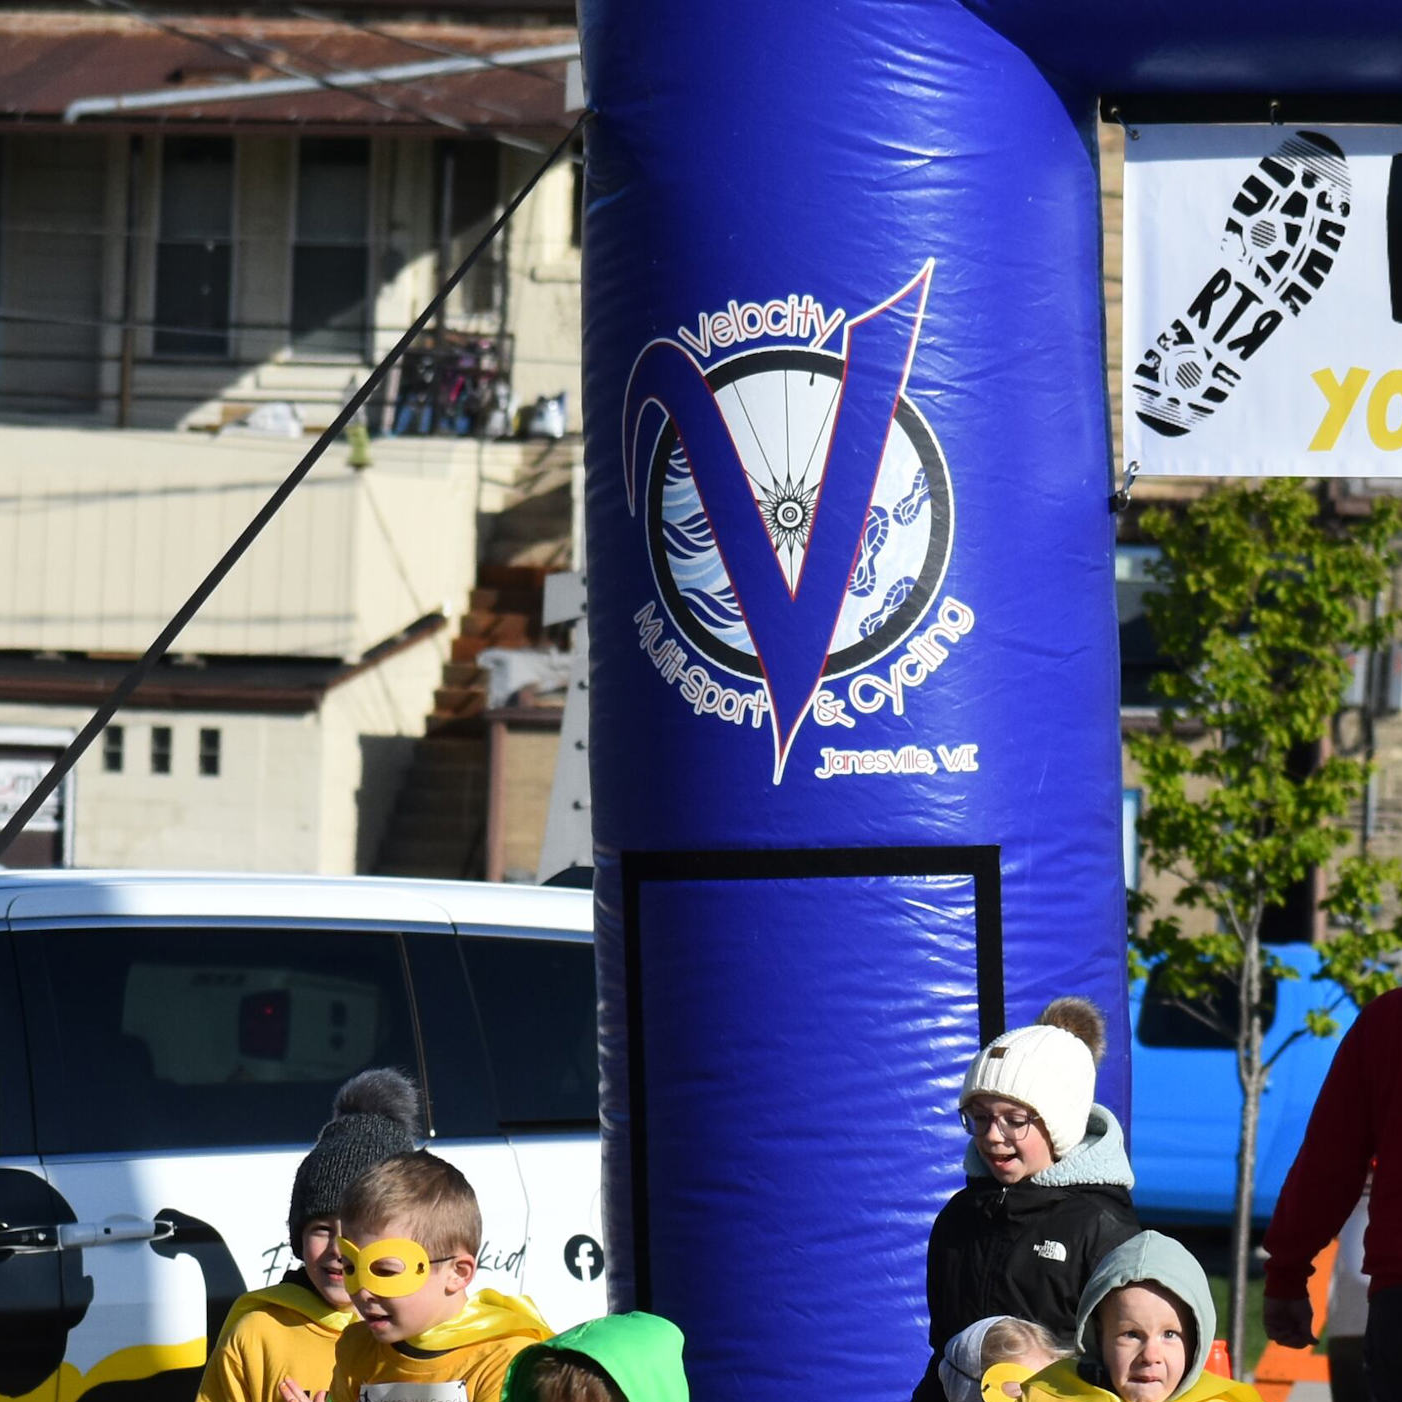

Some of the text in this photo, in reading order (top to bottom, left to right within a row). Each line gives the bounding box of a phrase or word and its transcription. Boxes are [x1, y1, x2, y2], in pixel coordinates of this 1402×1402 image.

[678, 295, 845, 358] Velocity
[633, 596, 975, 729] Multi-Sport & Cycling
[815, 745, 979, 779] Janesville, WI
